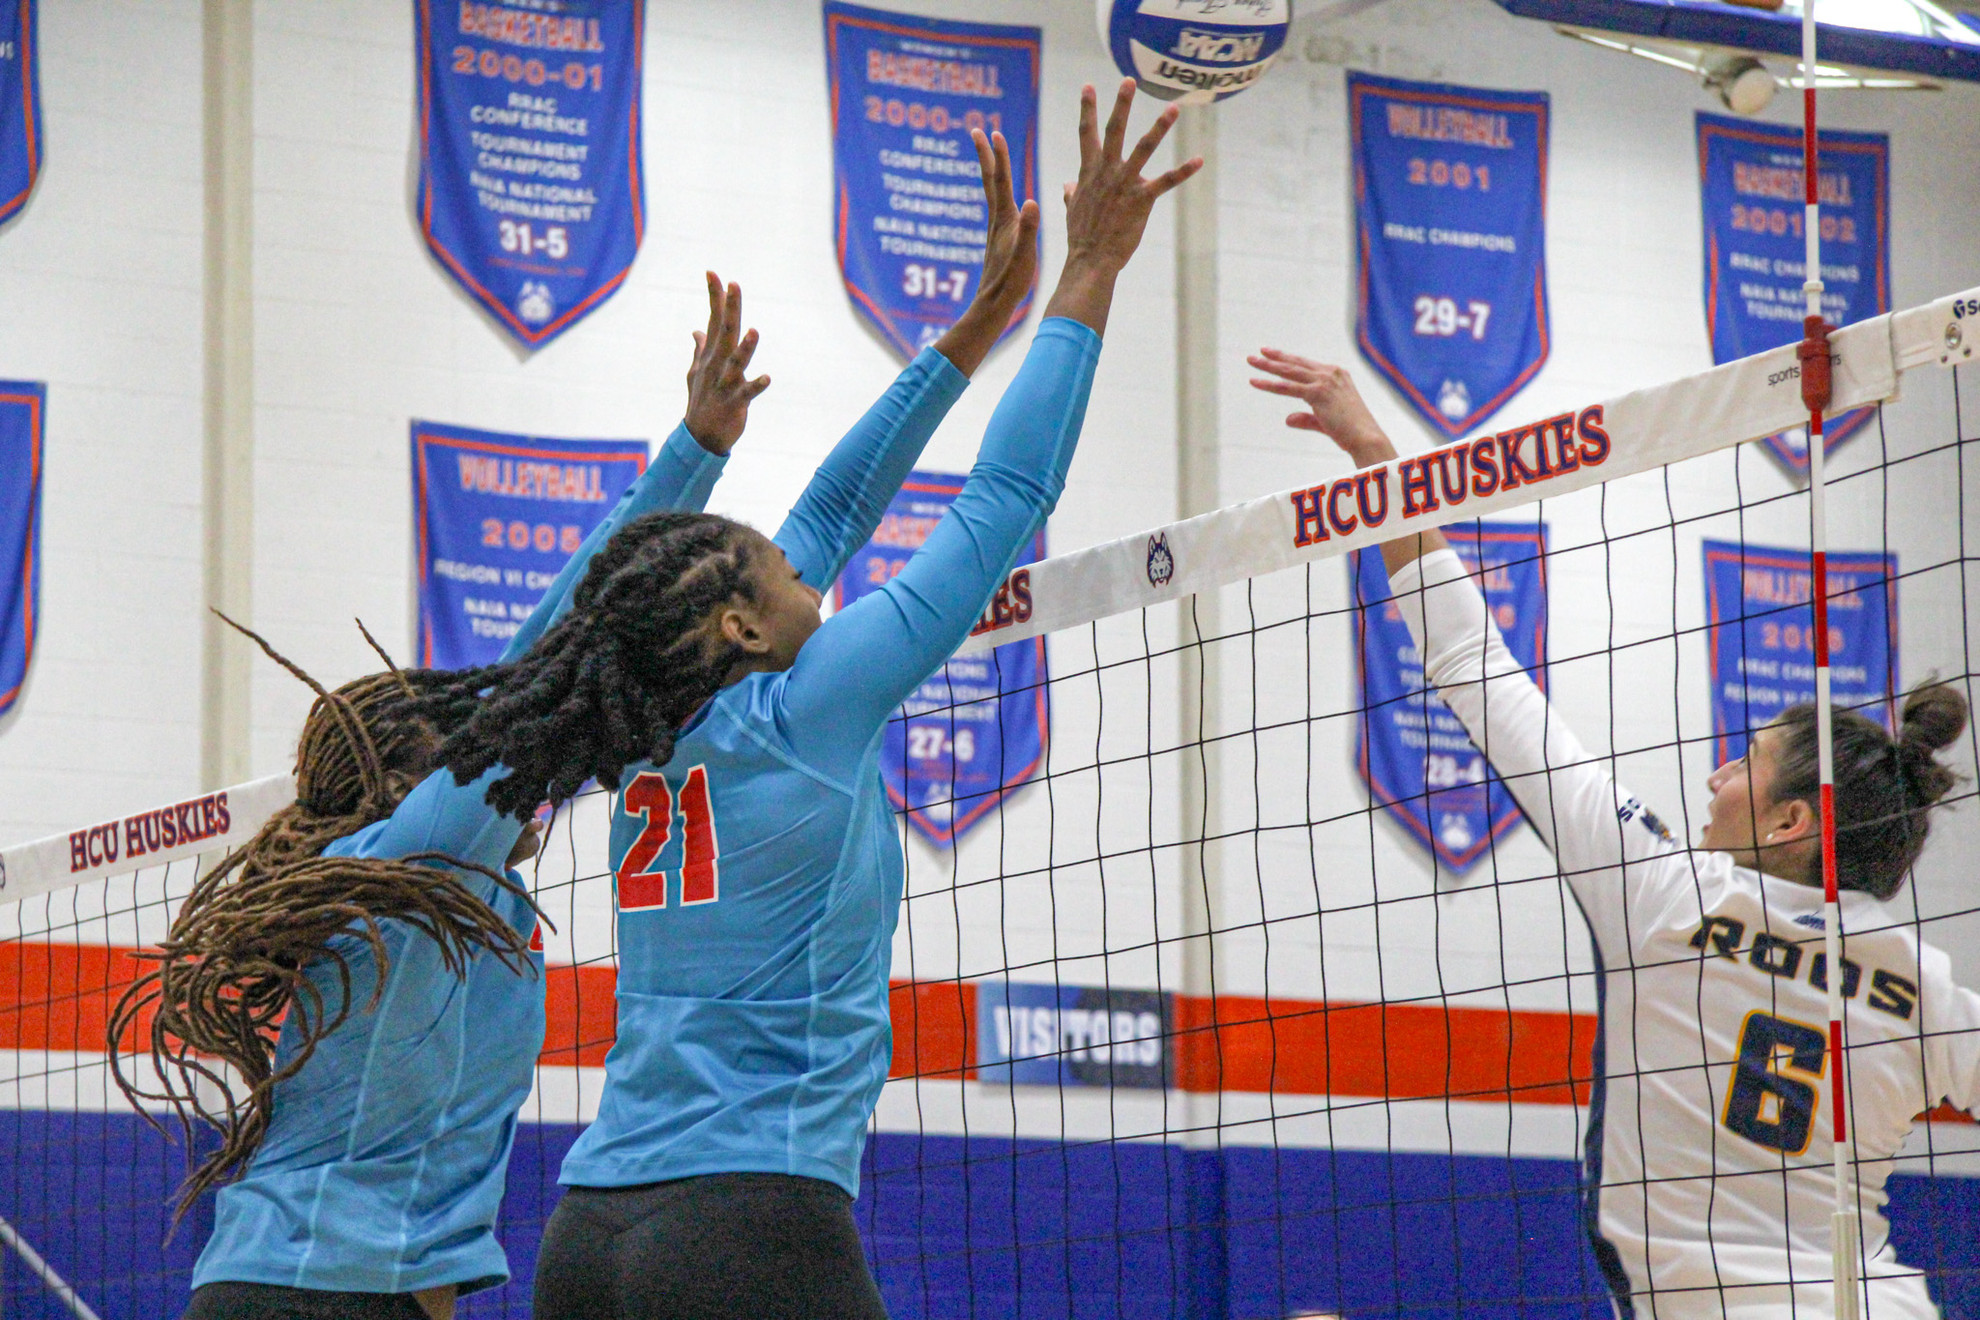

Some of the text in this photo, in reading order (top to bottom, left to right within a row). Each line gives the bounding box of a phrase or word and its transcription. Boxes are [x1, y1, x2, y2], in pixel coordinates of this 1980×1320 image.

[459, 1, 604, 51] BASKETBALL
[1171, 30, 1264, 62] NCAA
[453, 46, 603, 90] 2000-01
[867, 48, 1002, 98] BASKETBALL
[1157, 60, 1265, 90] molten
[470, 105, 588, 136] CONFERENCE
[864, 95, 1002, 134] 2000-01
[1386, 103, 1514, 149] VOLLEYBALL
[471, 131, 588, 161] TOURNAMENT
[879, 149, 982, 178] CONFERENC
[478, 151, 581, 181] CHAMPIONS
[1407, 157, 1490, 192] 2001
[1733, 161, 1852, 206] BASKETALL
[478, 190, 593, 222] TOURNAMENT
[509, 181, 598, 204] NATIONAL
[890, 192, 984, 222] CHAMPIONS
[499, 220, 568, 259] 31-5
[918, 222, 988, 246] NATIONA
[1428, 228, 1516, 252] CHAMPIONS
[903, 264, 968, 301] 31-7
[1413, 295, 1492, 341] 29-7
[458, 453, 607, 503] VOLLEYBALL
[1291, 405, 1611, 548] HCU HUSKIES
[908, 727, 975, 763] 27-6
[69, 791, 231, 873] HCU HUSKIES
[615, 763, 719, 913] 21
[1688, 915, 1918, 1021] ROOS
[994, 1005, 1163, 1067] VISITORS
[1720, 1008, 1831, 1157] 6
